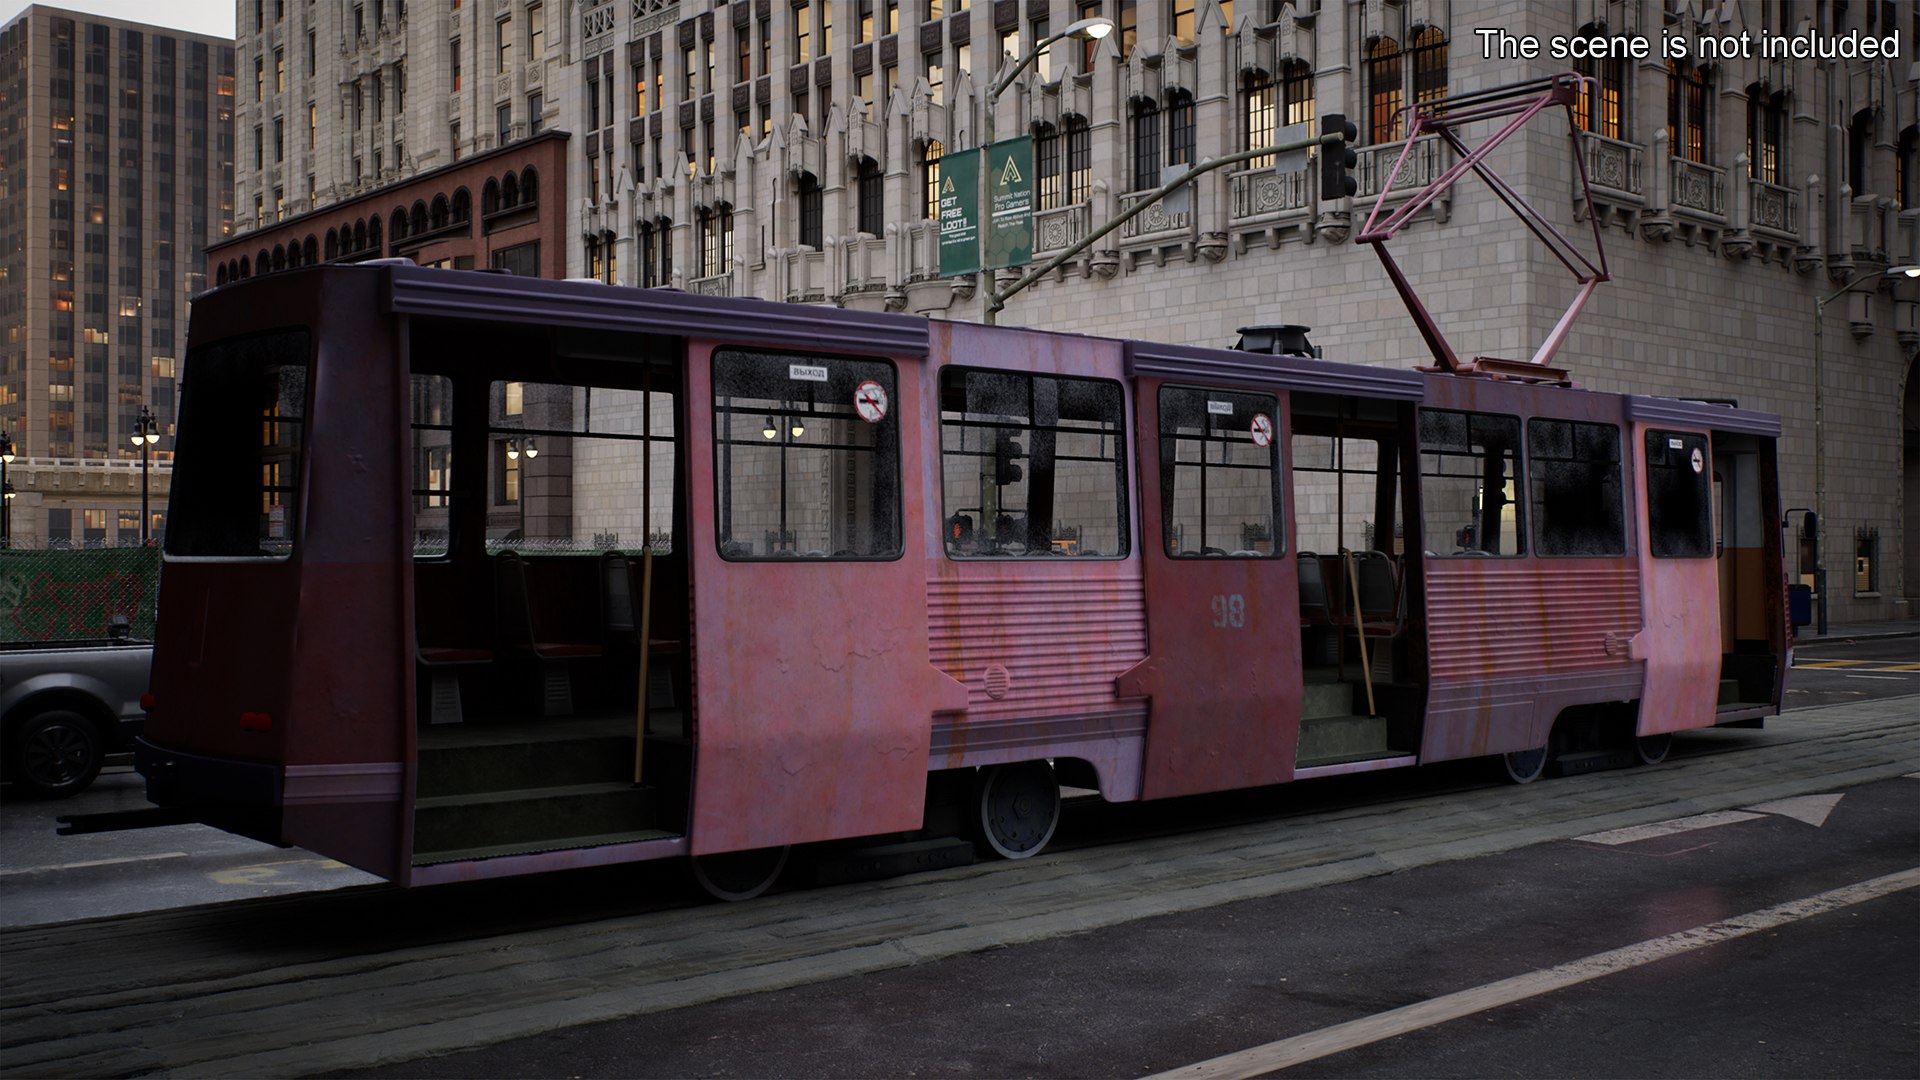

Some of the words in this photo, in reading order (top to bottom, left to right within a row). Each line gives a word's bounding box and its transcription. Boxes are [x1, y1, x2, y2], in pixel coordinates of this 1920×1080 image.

[941, 196, 957, 208] GET
[993, 193, 1013, 202] Summit
[1014, 190, 1031, 198] Nation
[994, 203, 1005, 211] Pro
[1005, 199, 1030, 209] Gamers
[941, 207, 963, 220] FREE
[1212, 594, 1245, 628] 98
